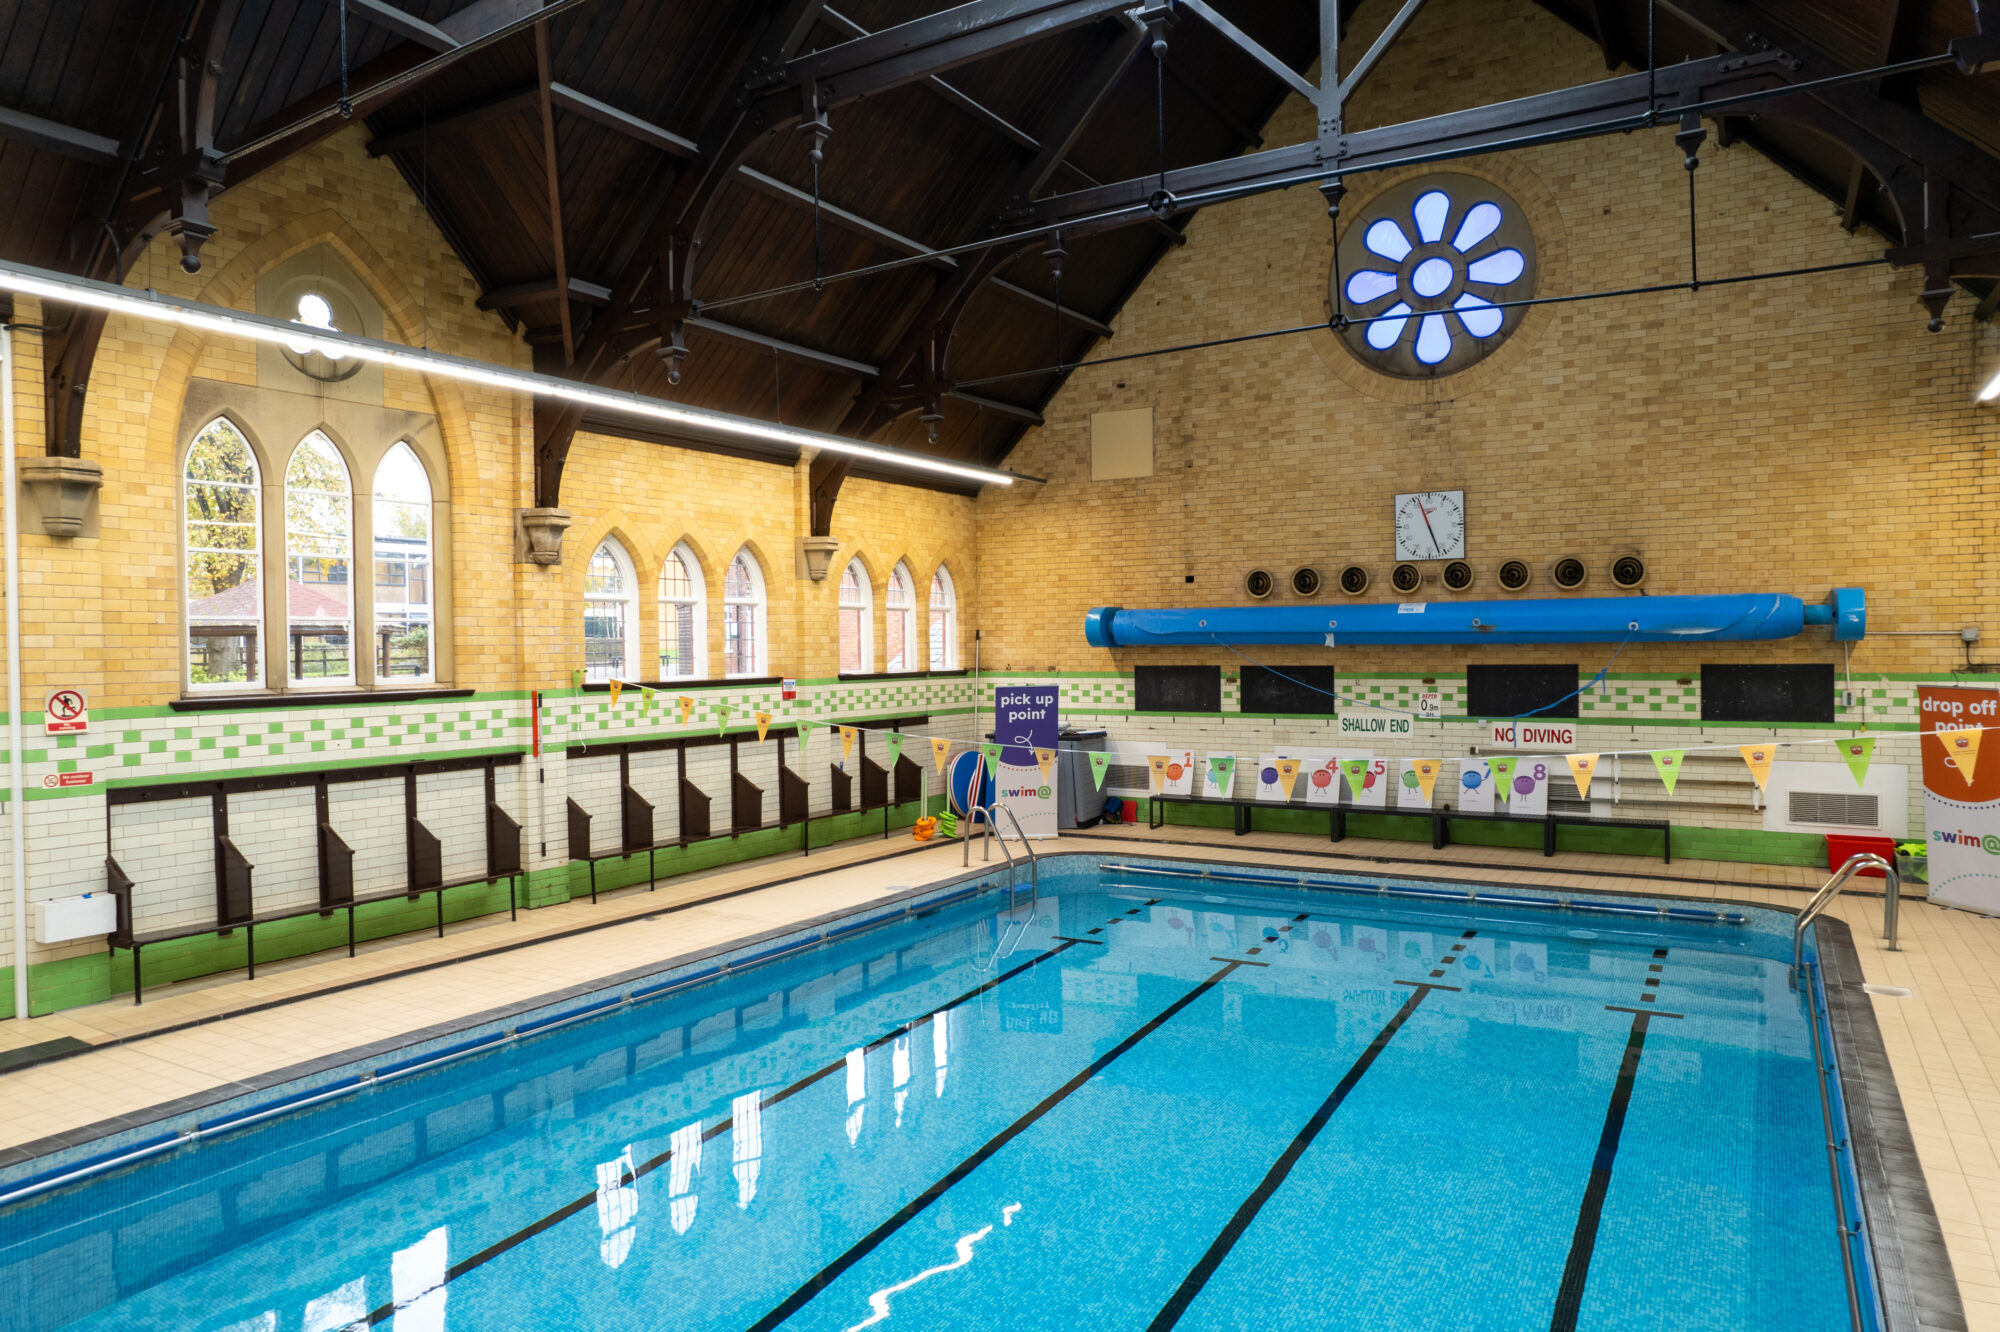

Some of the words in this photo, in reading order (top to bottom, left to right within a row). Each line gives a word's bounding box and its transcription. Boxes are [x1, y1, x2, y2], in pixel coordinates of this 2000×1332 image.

[1001, 693, 1031, 708] pick
[1036, 695, 1054, 707] up
[1922, 696, 1964, 717] drop
[1969, 699, 1997, 716] off
[1009, 708, 1046, 723] point
[1342, 718, 1386, 732] SHALLOW
[1390, 719, 1410, 733] END
[1495, 728, 1516, 742] NO
[1523, 728, 1573, 744] DIVING
[1184, 752, 1192, 767] 1
[1325, 757, 1339, 773] 4
[1374, 760, 1386, 775] 5
[1533, 763, 1546, 781] 8
[1001, 785, 1052, 799] swim@
[1932, 829, 2000, 856] swim@
